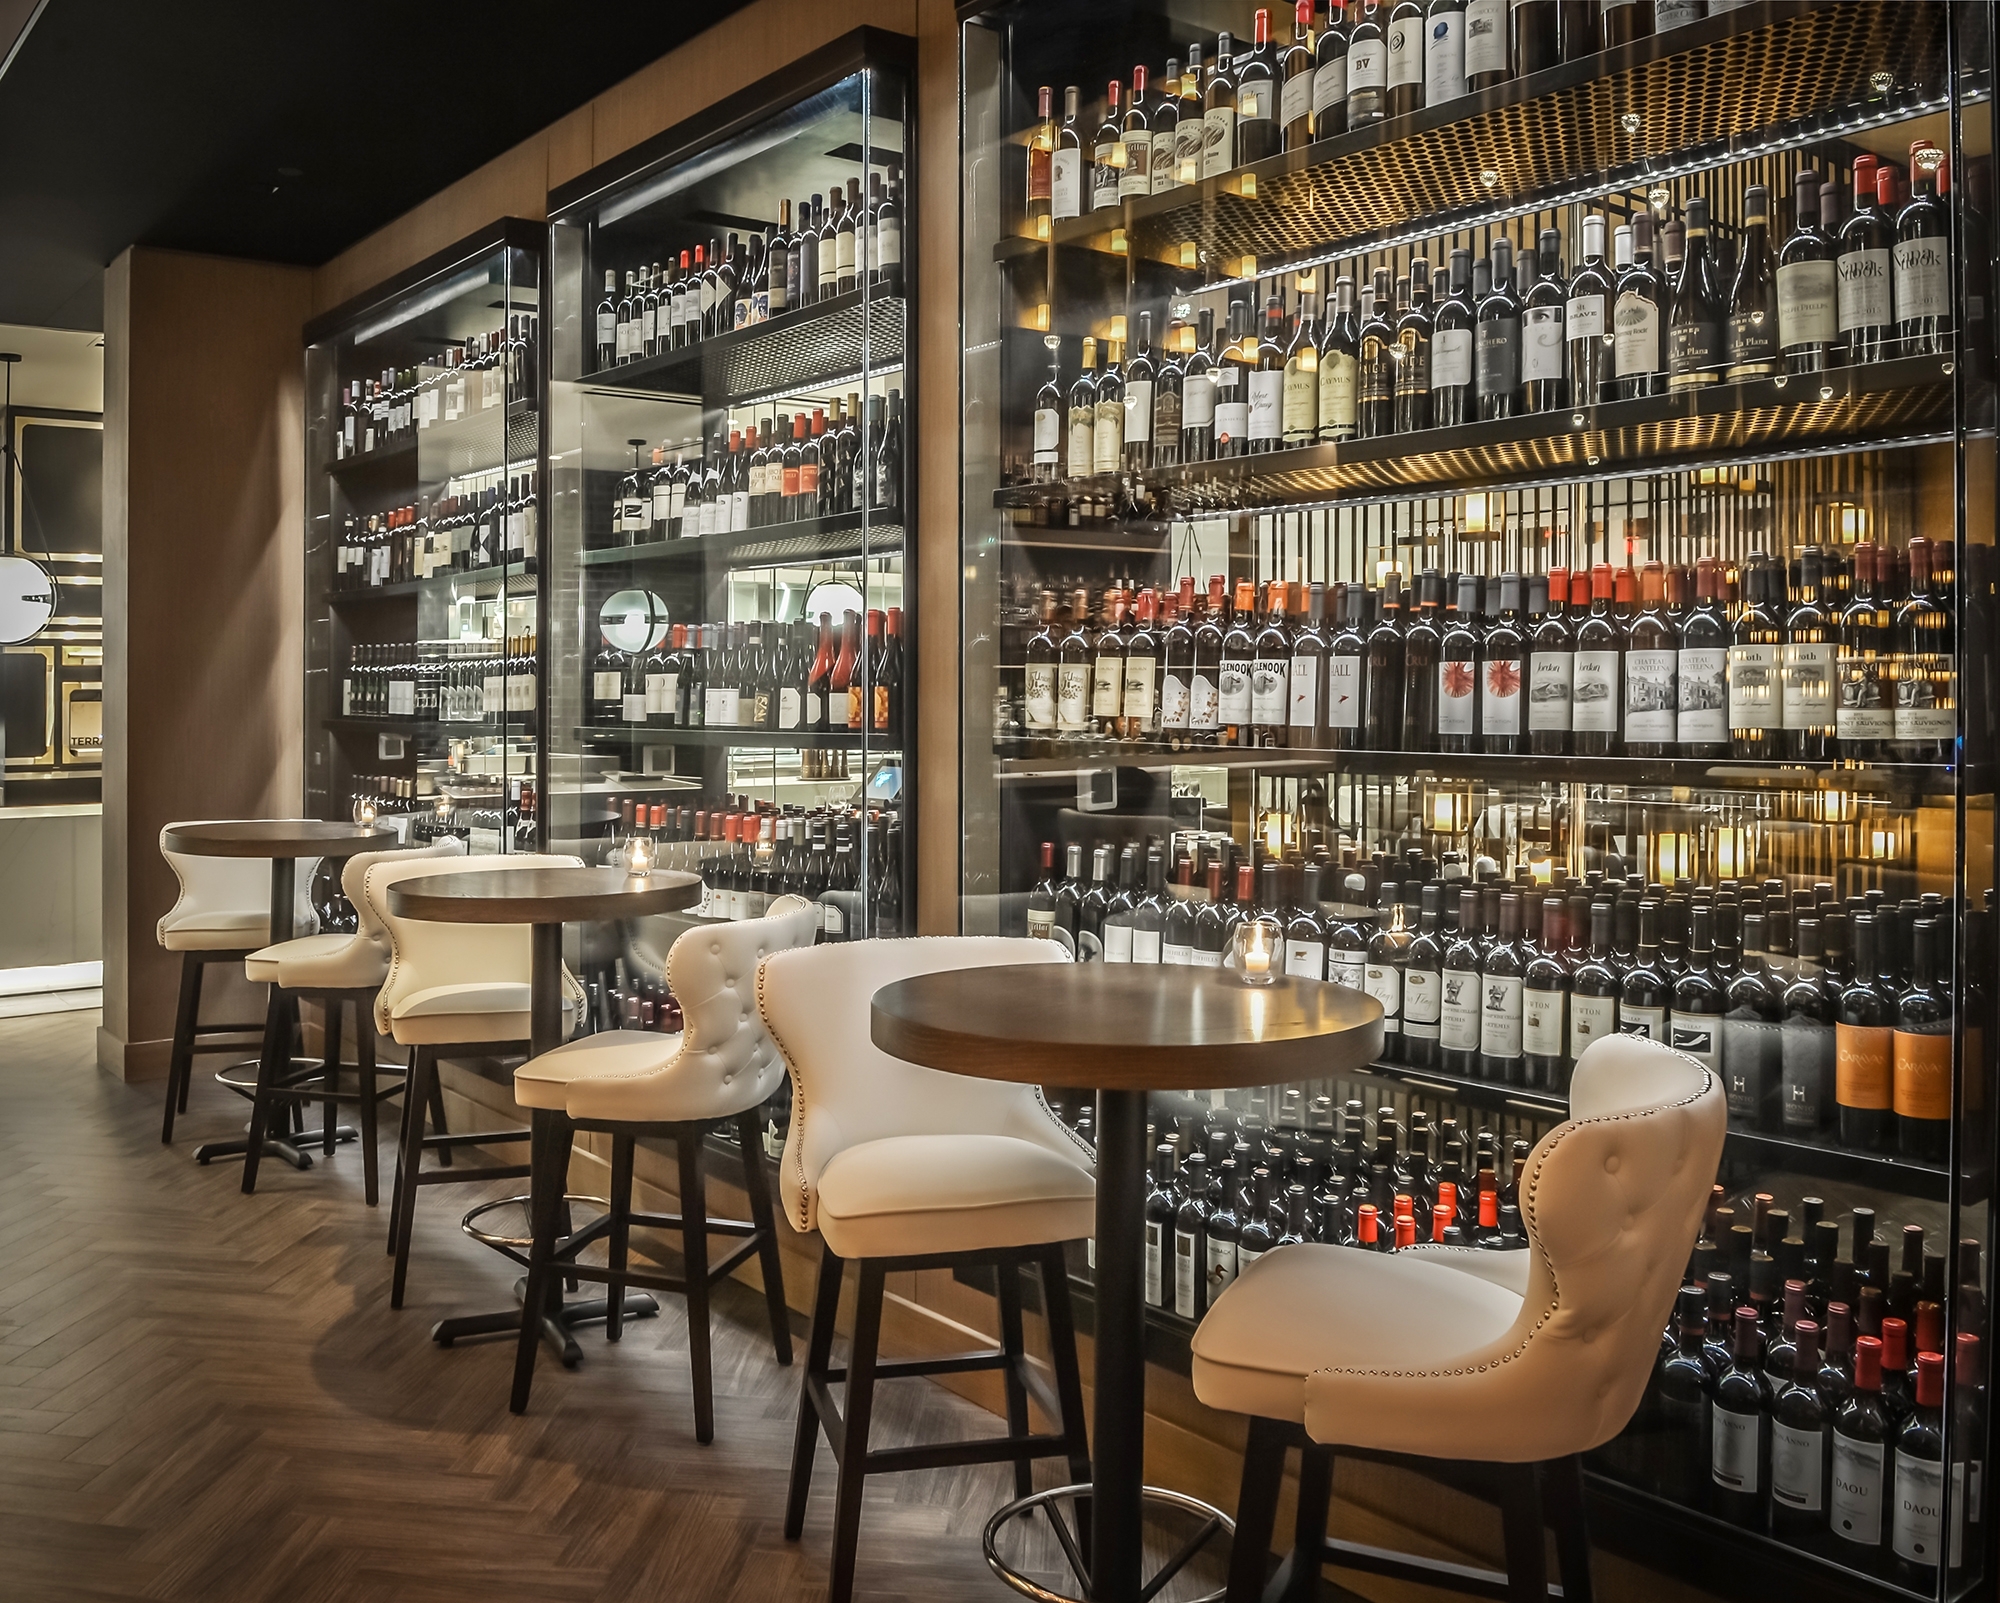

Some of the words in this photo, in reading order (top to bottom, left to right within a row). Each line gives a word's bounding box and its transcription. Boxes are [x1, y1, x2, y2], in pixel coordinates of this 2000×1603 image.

[1355, 58, 1370, 71] BV
[1746, 337, 1768, 346] Plana
[1687, 347, 1709, 356] Plana
[1320, 376, 1351, 387] CAYMUS
[1526, 1001, 1550, 1009] EWTON
[1836, 1476, 1868, 1497] DAOU
[1903, 1499, 1939, 1518] DAOU
